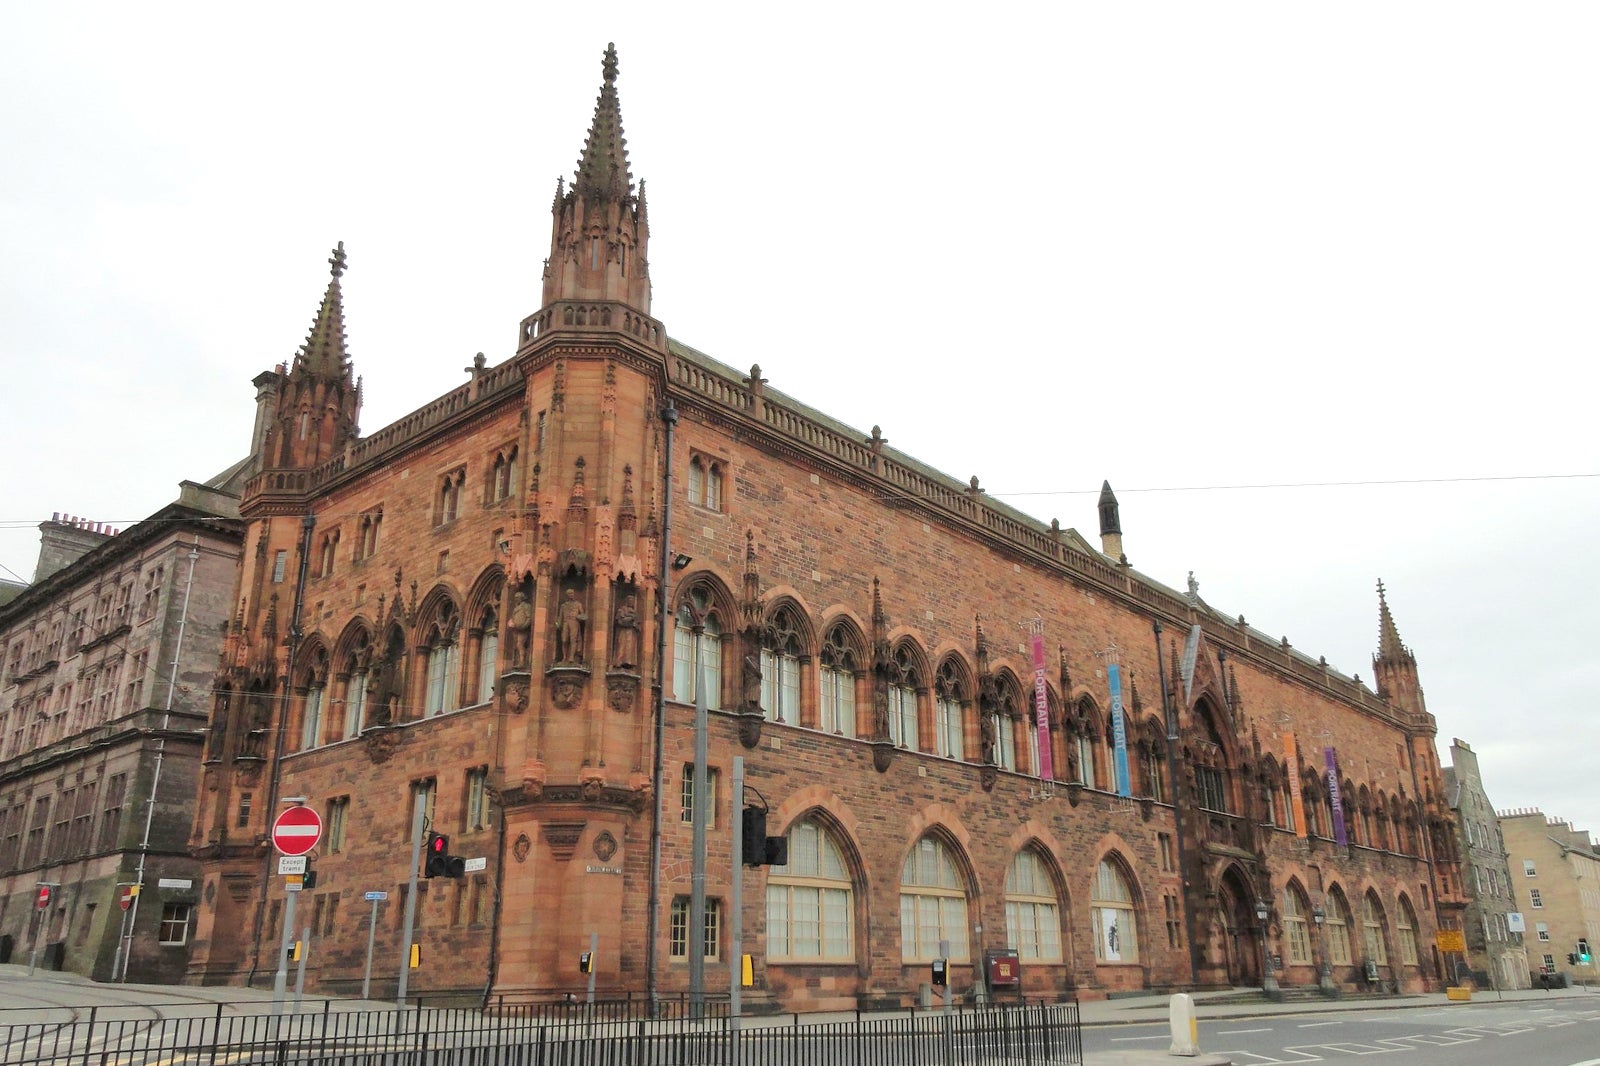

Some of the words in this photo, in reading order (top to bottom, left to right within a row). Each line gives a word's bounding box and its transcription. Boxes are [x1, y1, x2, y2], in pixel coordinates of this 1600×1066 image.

[1035, 668, 1049, 728] PORTRAIT
[1112, 694, 1125, 749] PORTRAIT
[1286, 756, 1300, 797] PORTRAIT
[1328, 769, 1341, 811] PORTRAIT
